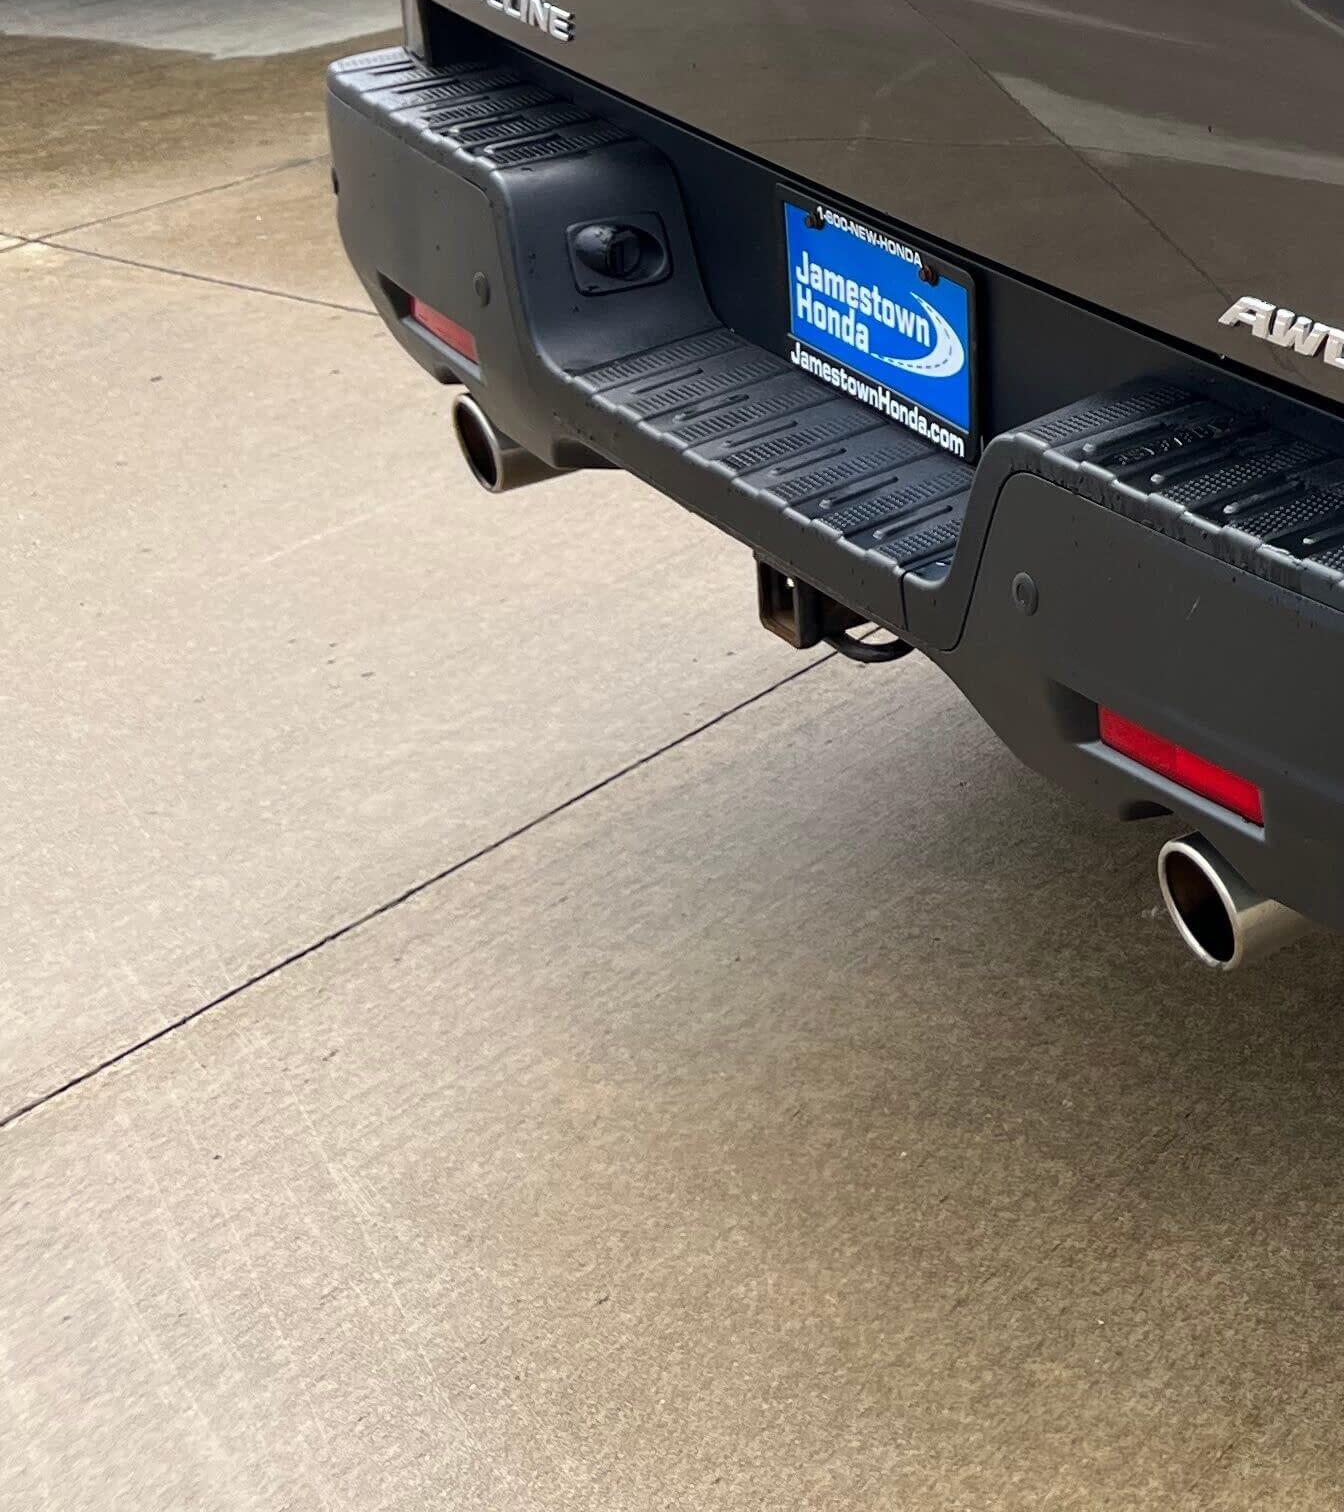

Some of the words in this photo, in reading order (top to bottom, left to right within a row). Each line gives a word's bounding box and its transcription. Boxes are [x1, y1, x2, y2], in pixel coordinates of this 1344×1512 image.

[816, 206, 923, 268] 1-800-NEW-HONDA
[795, 250, 931, 348] Jamestown
[796, 283, 871, 355] Honda
[790, 341, 965, 458] JamestownHonda.com
